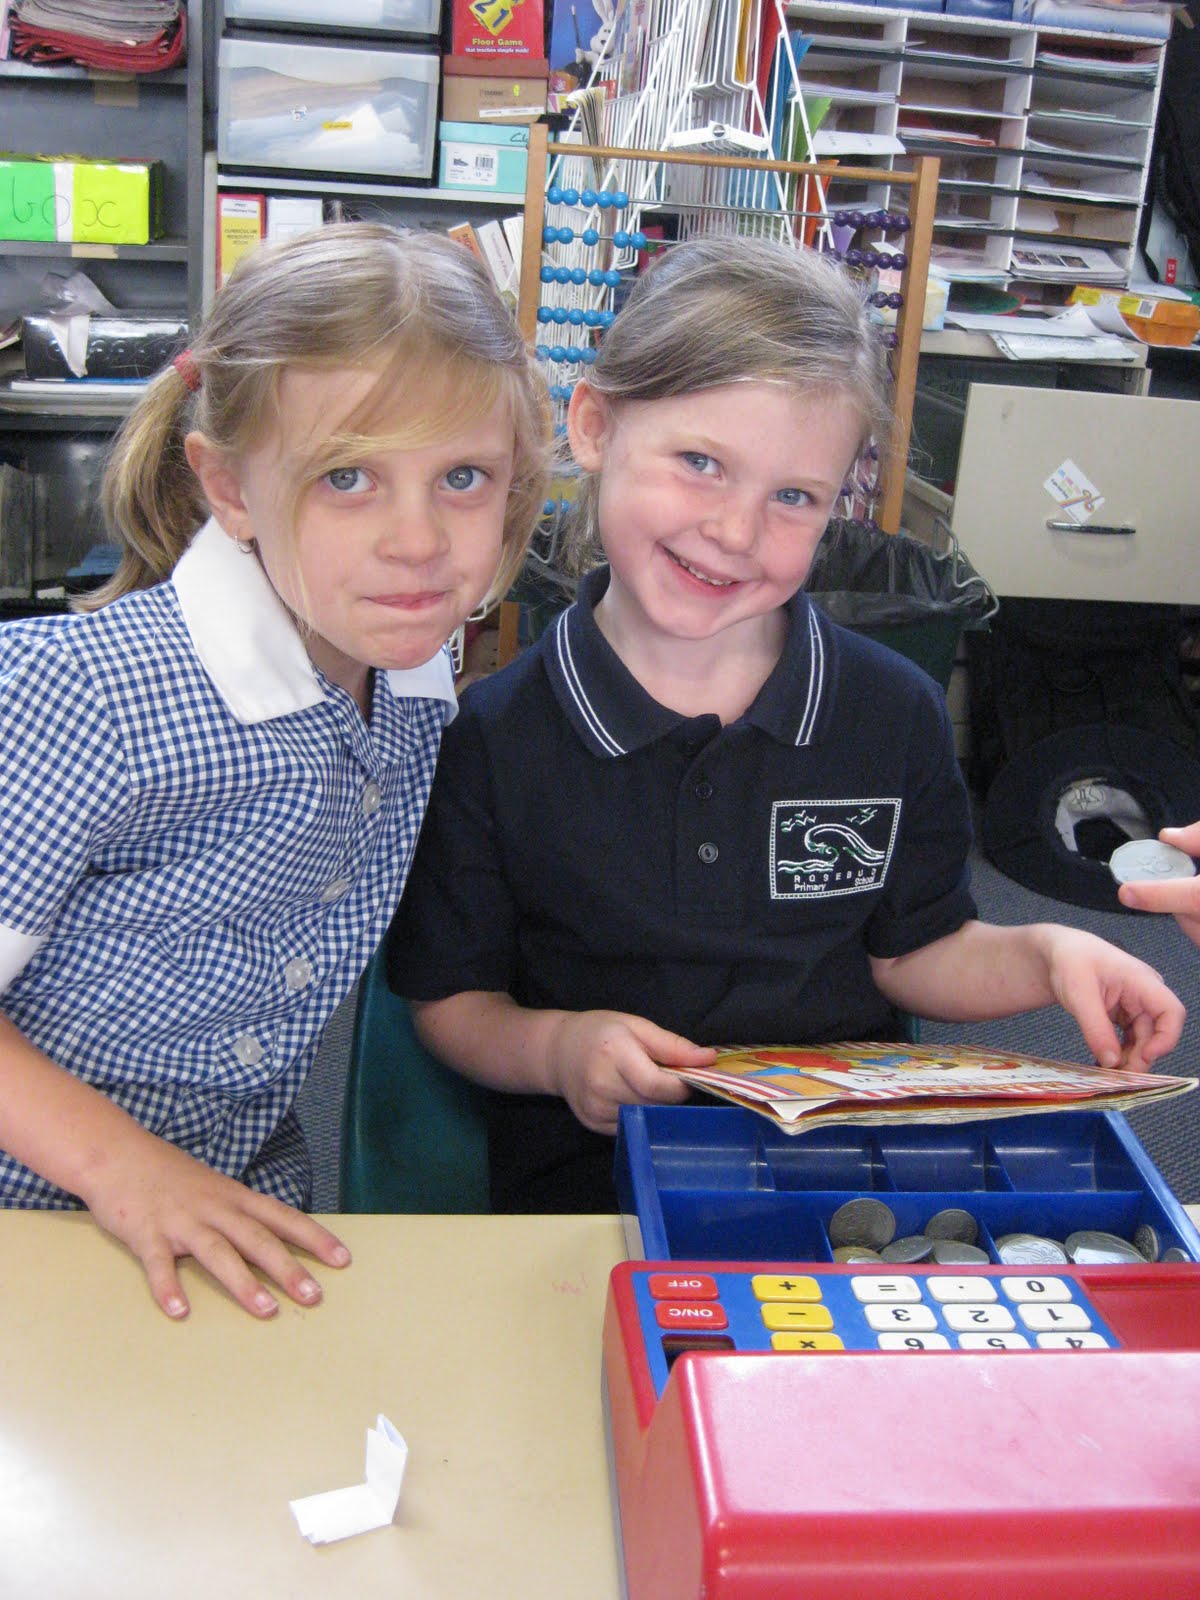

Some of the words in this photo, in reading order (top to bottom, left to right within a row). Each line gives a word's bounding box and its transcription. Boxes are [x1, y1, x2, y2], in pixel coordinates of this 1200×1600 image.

[492, 8, 510, 28] 1
[472, 37, 496, 46] Floor
[497, 37, 524, 46] Game
[12, 175, 121, 228] box
[794, 868, 876, 883] ROSEBUD
[794, 882, 826, 891] Primary
[854, 875, 876, 887] School
[667, 1279, 702, 1289] OFF
[1025, 1279, 1046, 1294] 0
[669, 1307, 713, 1318] ON/C
[891, 1308, 912, 1322] 3
[968, 1309, 990, 1323] 2
[1047, 1307, 1064, 1322] 1
[1064, 1336, 1084, 1350] 4
